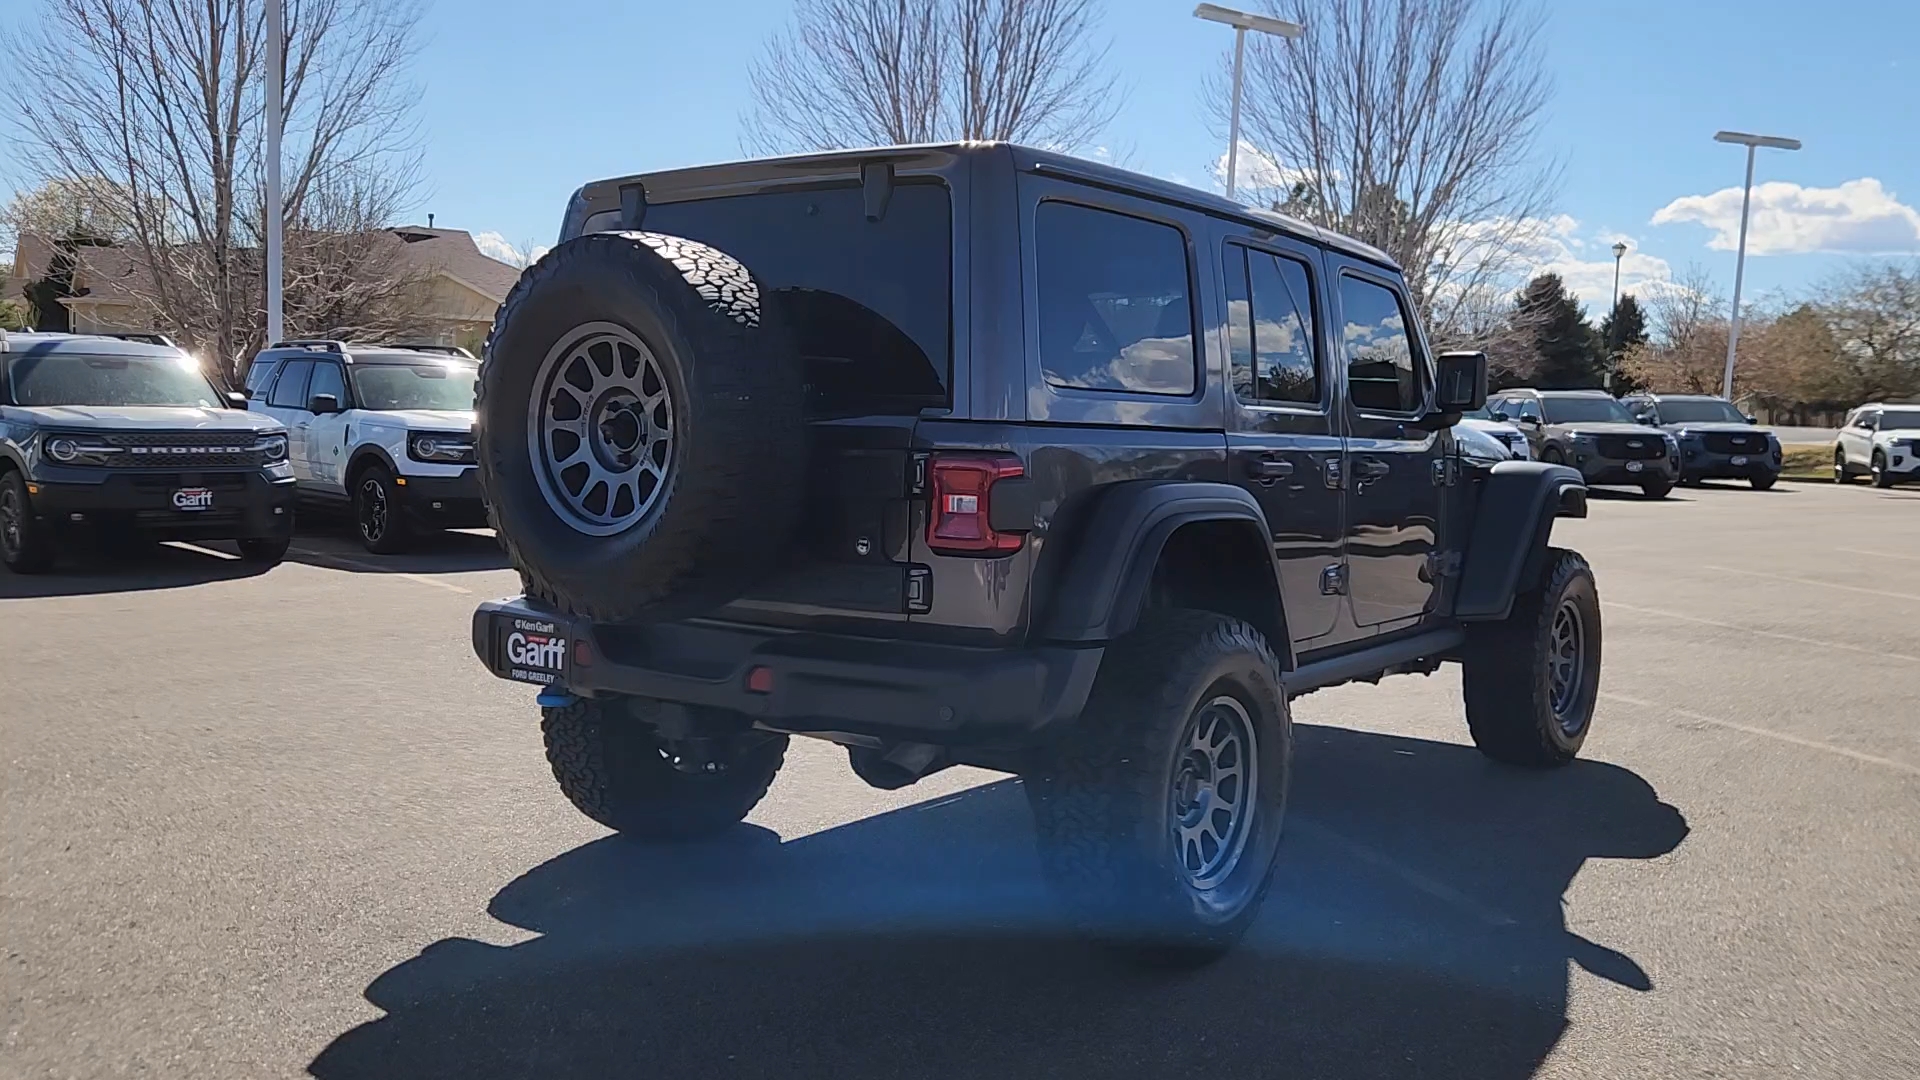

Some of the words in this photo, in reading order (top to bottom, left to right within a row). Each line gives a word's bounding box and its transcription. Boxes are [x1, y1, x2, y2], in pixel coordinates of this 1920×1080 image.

[173, 491, 213, 506] Garff
[521, 619, 536, 631] Ken
[536, 621, 554, 634] Garff
[507, 632, 566, 670] Garff
[511, 668, 528, 680] FORD
[528, 671, 555, 684] GREELEY
